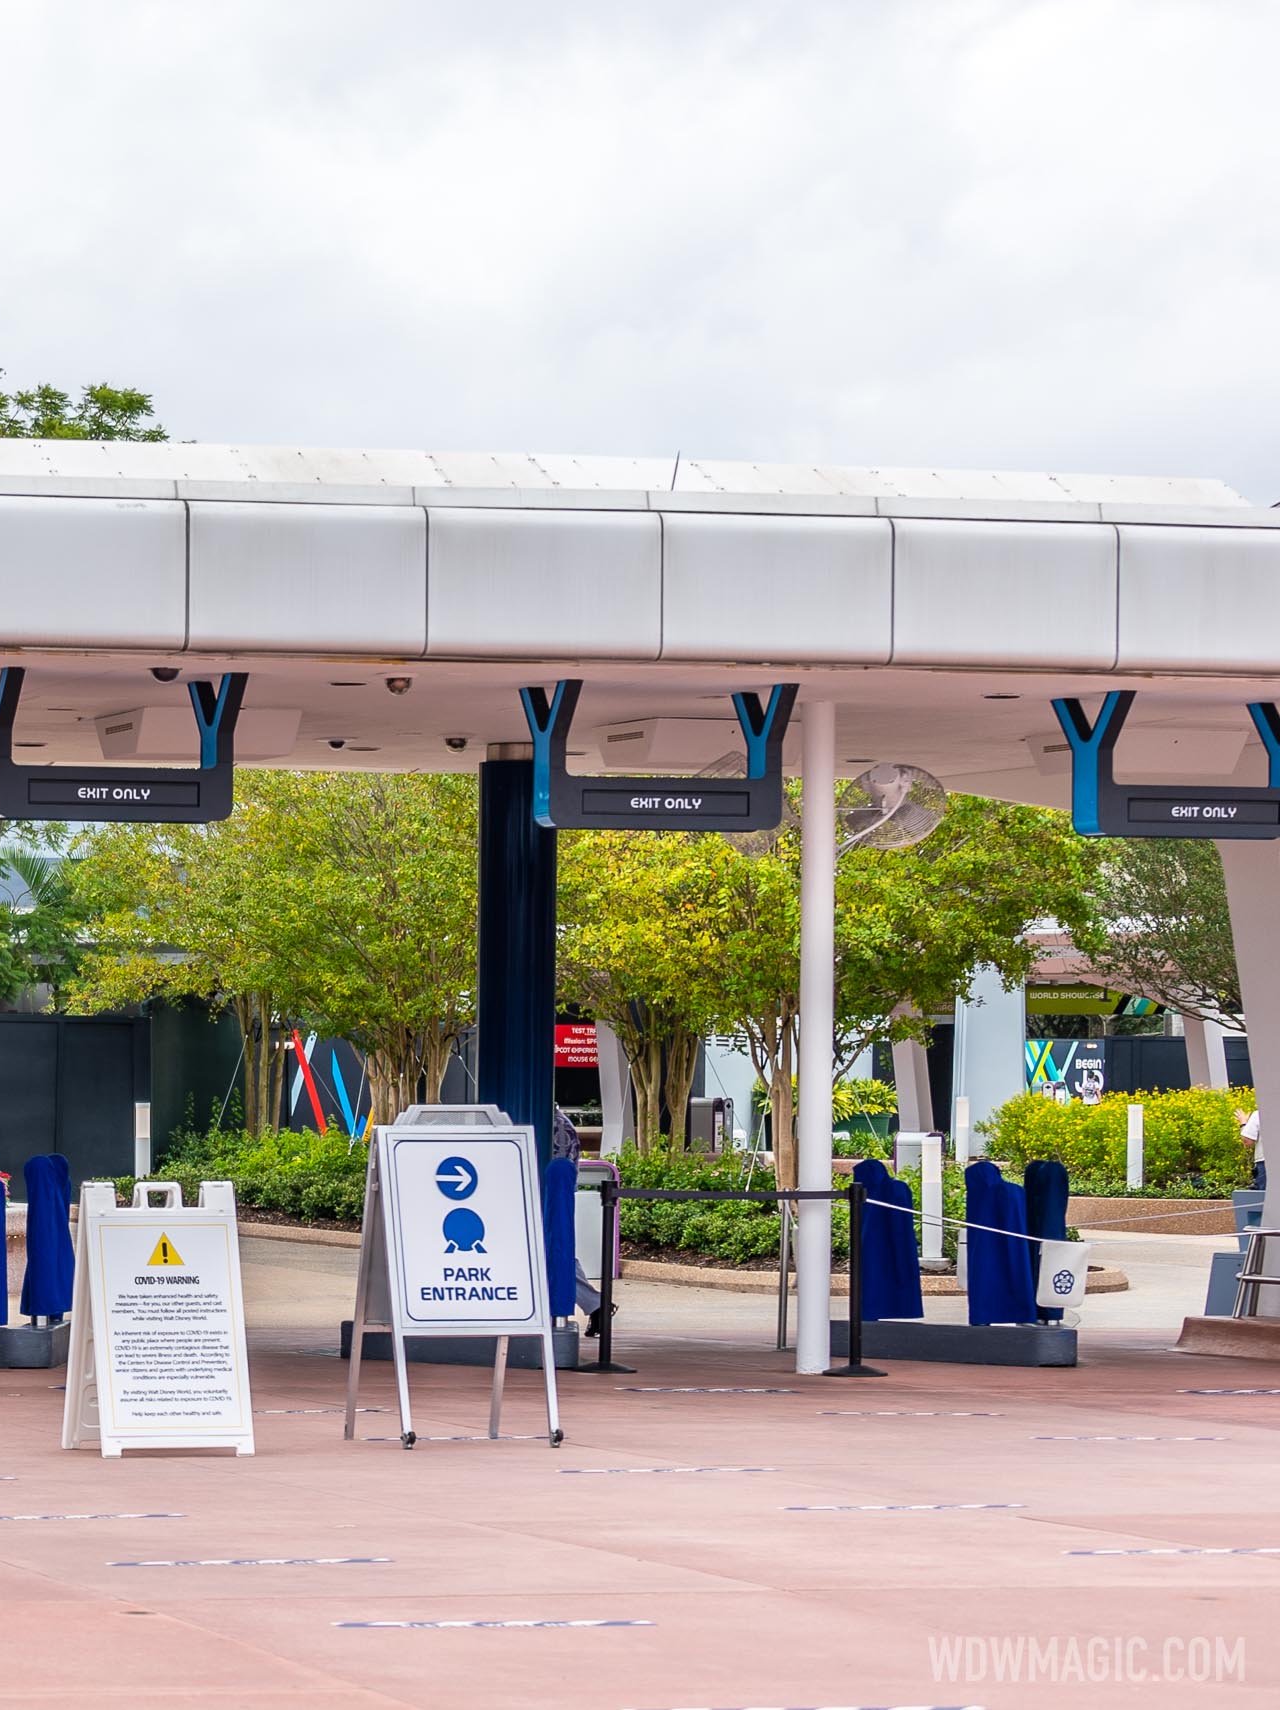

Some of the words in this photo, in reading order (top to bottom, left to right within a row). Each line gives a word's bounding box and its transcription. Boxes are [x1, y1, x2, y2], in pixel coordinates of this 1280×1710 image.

[77, 787, 109, 799] EXIT
[112, 787, 151, 800] ONLY
[630, 797, 662, 809] EXIT
[664, 797, 702, 810] ONLY
[1171, 806, 1201, 817] EXIT
[1203, 806, 1237, 818] ONLY
[1075, 1058, 1102, 1070] BEGIN
[134, 1276, 165, 1285] COVID-19
[165, 1276, 200, 1285] WARNING
[443, 1267, 492, 1282] PARK
[420, 1286, 519, 1301] ENTRANCE
